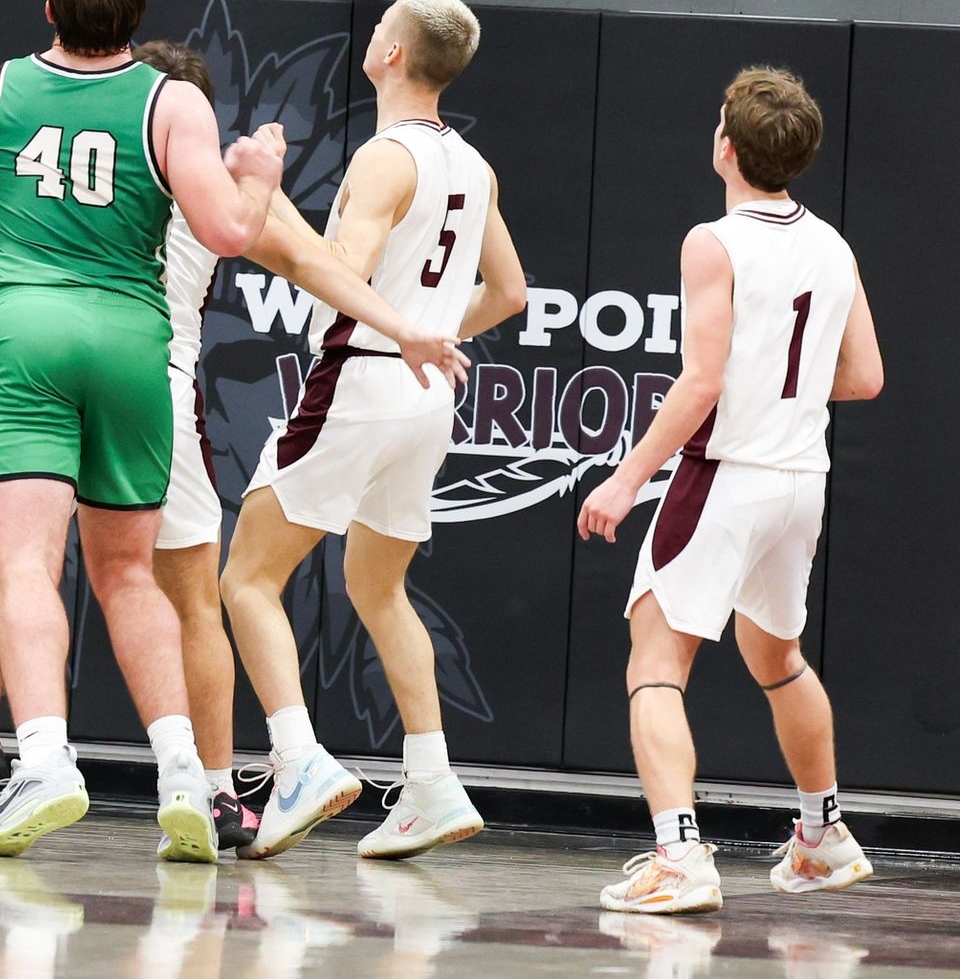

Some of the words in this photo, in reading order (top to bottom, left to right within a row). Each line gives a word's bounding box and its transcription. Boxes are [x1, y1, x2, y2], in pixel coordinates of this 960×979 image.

[14, 124, 118, 208] 40
[419, 192, 466, 289] 5
[518, 286, 682, 355] POI
[780, 290, 813, 400] 1
